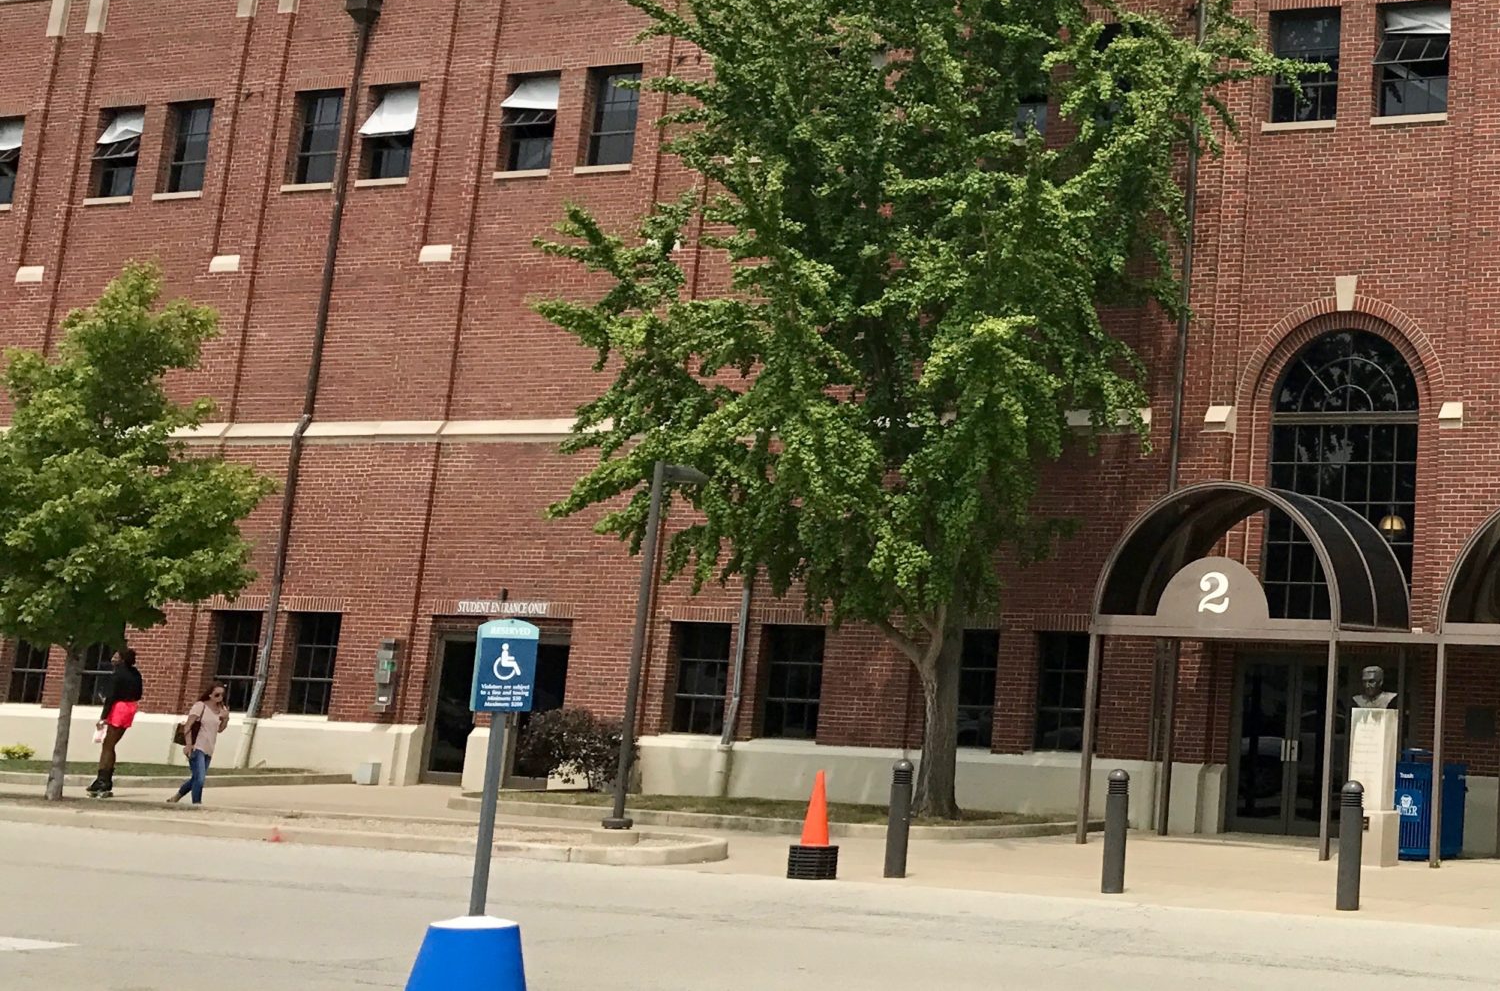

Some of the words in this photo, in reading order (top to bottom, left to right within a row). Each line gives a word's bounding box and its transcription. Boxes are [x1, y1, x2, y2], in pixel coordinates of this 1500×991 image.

[1198, 571, 1230, 614] 2
[458, 601, 490, 613] STUDENT
[491, 601, 528, 614] ENTRANCE
[528, 603, 547, 614] ONLY
[490, 626, 531, 636] RESERVED
